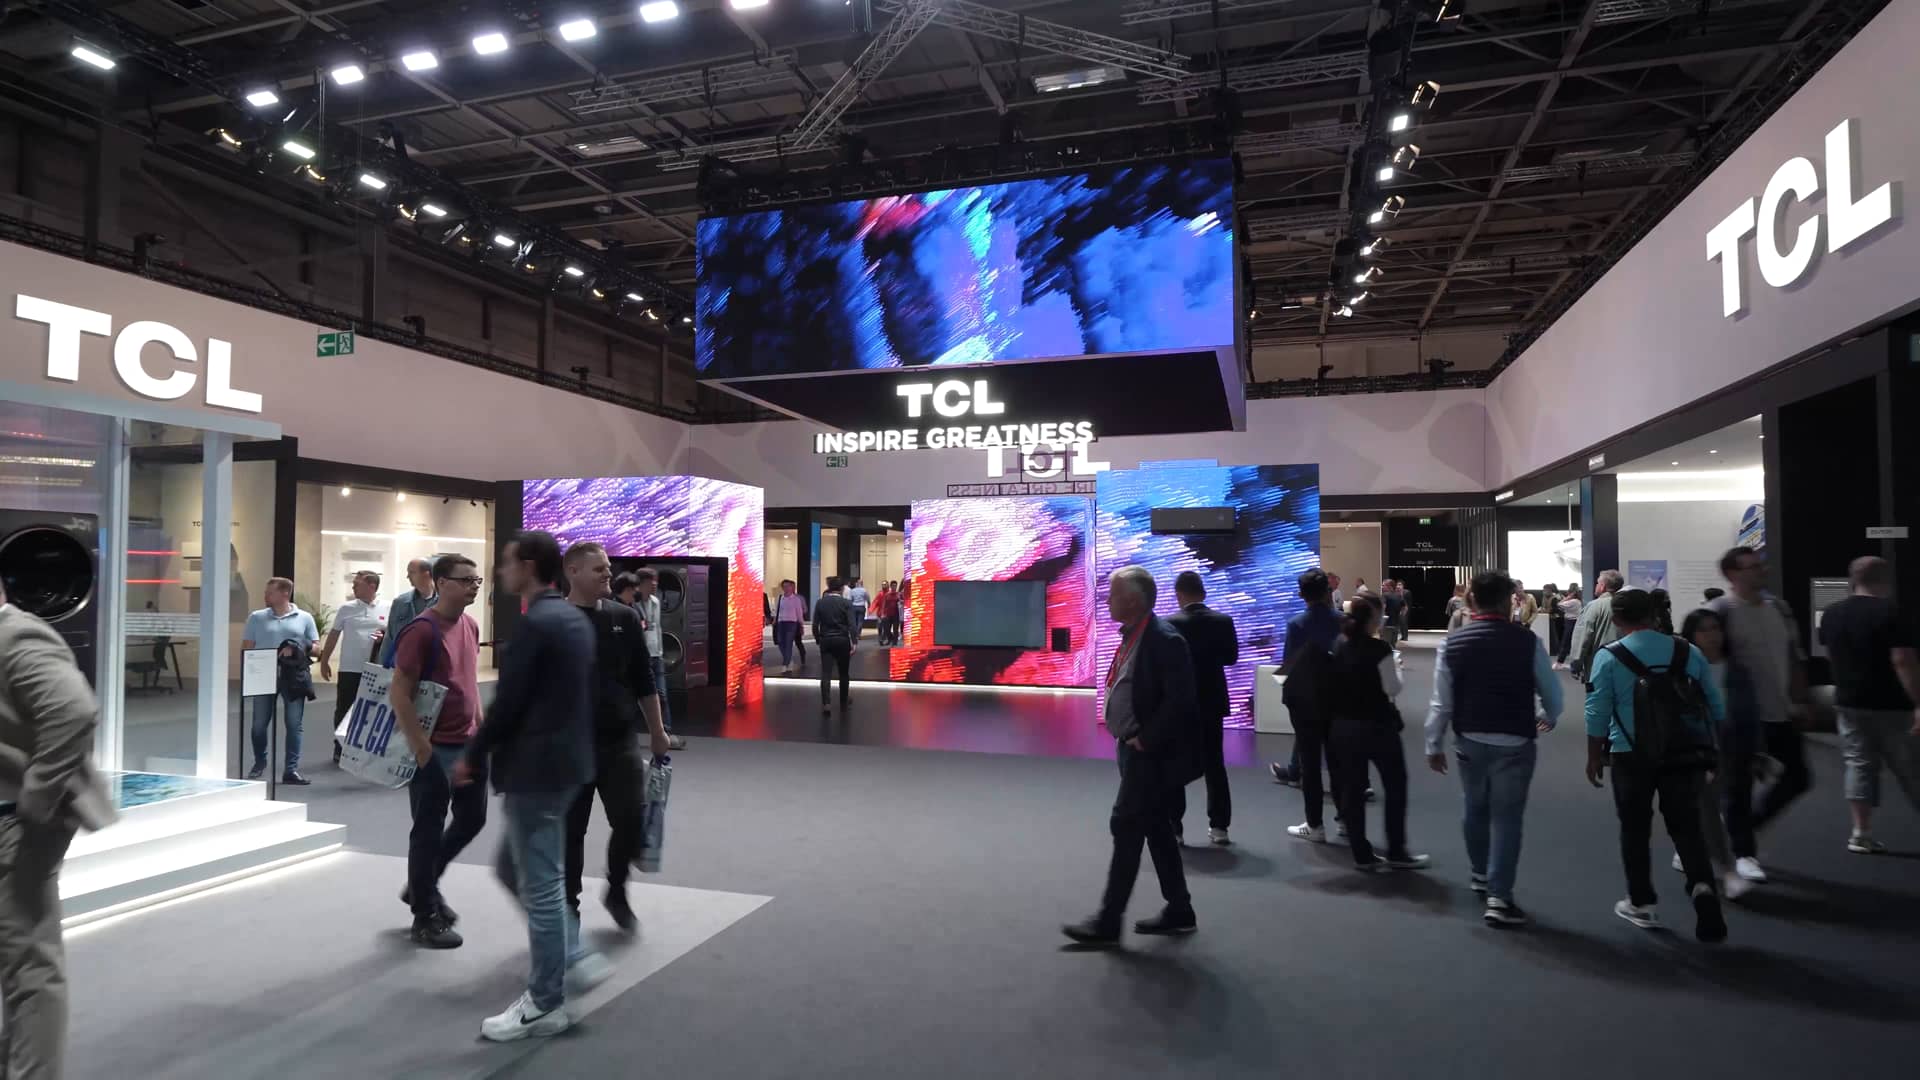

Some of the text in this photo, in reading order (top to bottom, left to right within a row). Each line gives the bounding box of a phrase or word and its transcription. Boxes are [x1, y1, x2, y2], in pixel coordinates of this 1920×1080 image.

[1706, 118, 1892, 318] TCL
[16, 294, 262, 413] TCL
[896, 379, 1005, 418] TCL
[816, 421, 1094, 454] INSPIRE GREATNESS
[973, 442, 1110, 478] TCL
